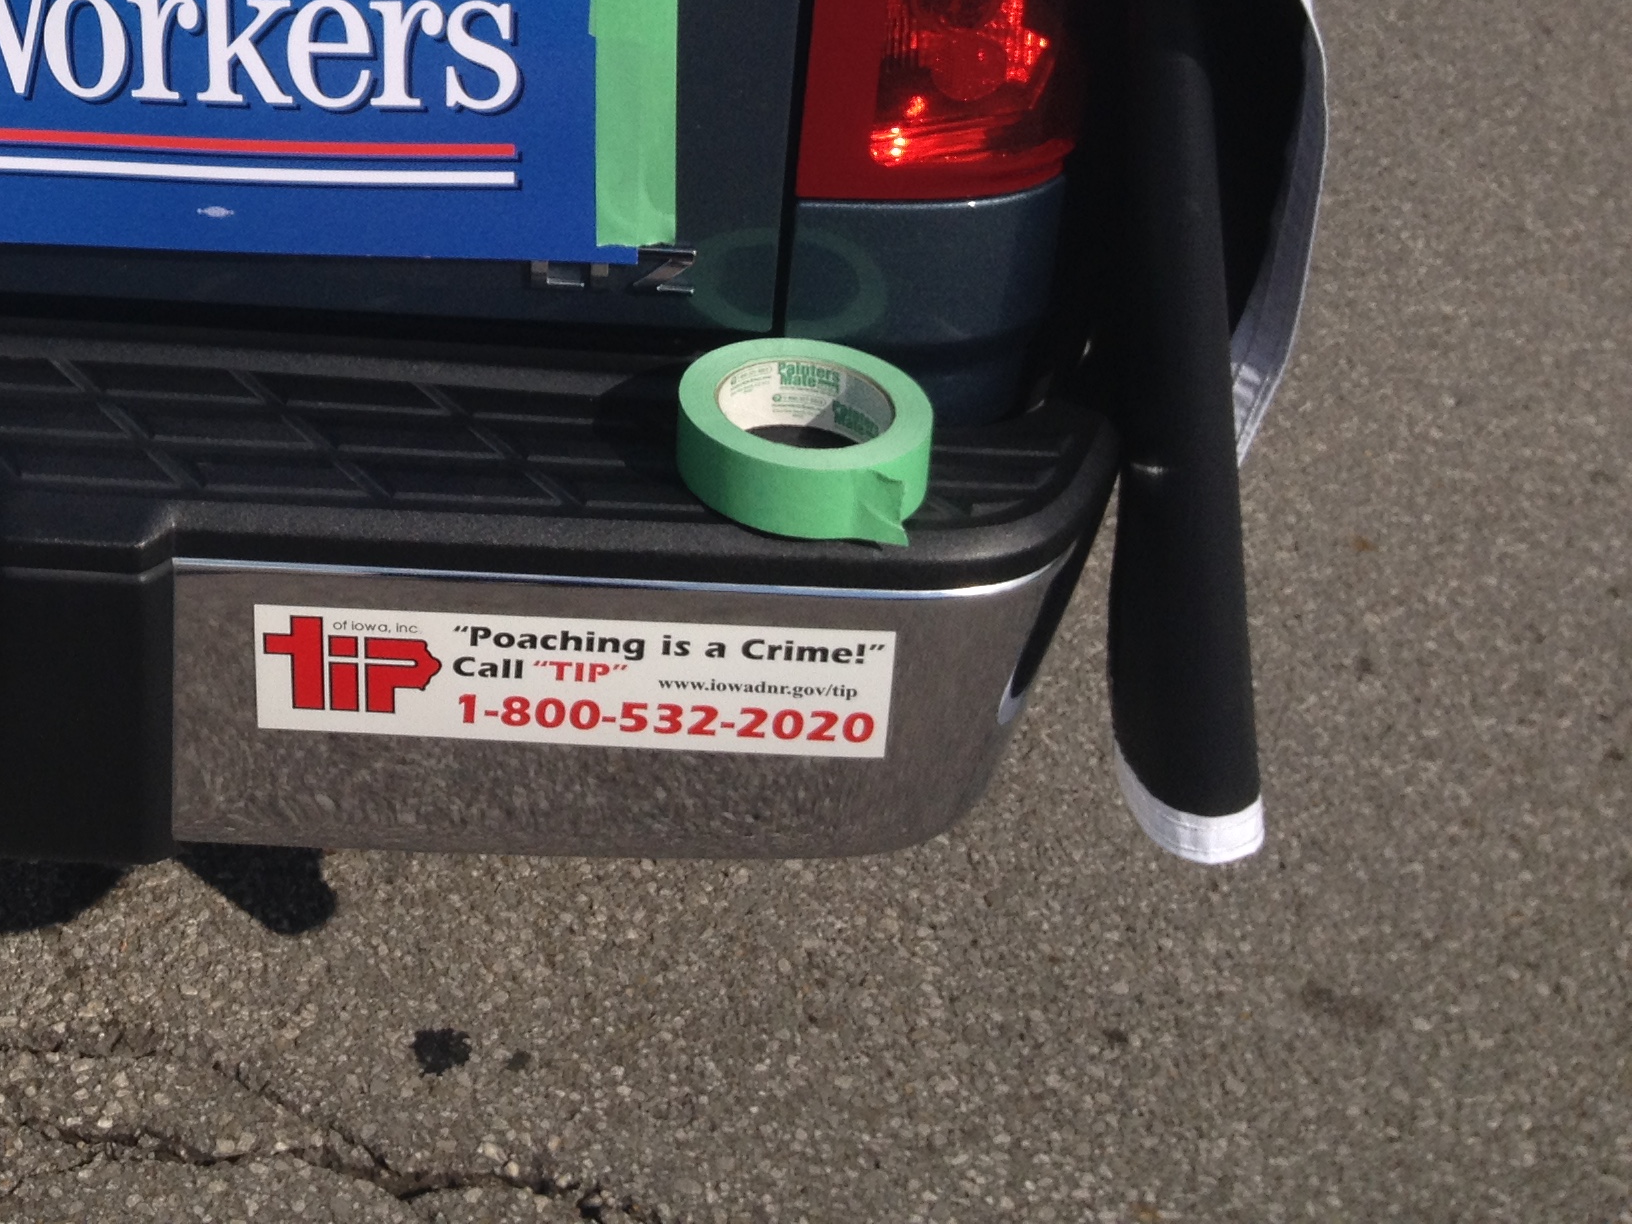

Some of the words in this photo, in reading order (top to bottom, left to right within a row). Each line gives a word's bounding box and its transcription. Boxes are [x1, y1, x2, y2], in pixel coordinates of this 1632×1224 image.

[332, 620, 348, 631] of
[661, 634, 691, 657] is
[704, 641, 727, 659] a
[452, 656, 524, 680] Call
[658, 678, 858, 701] www.iowadnr.gov/tip
[458, 693, 875, 744] 1-800-532-2020
